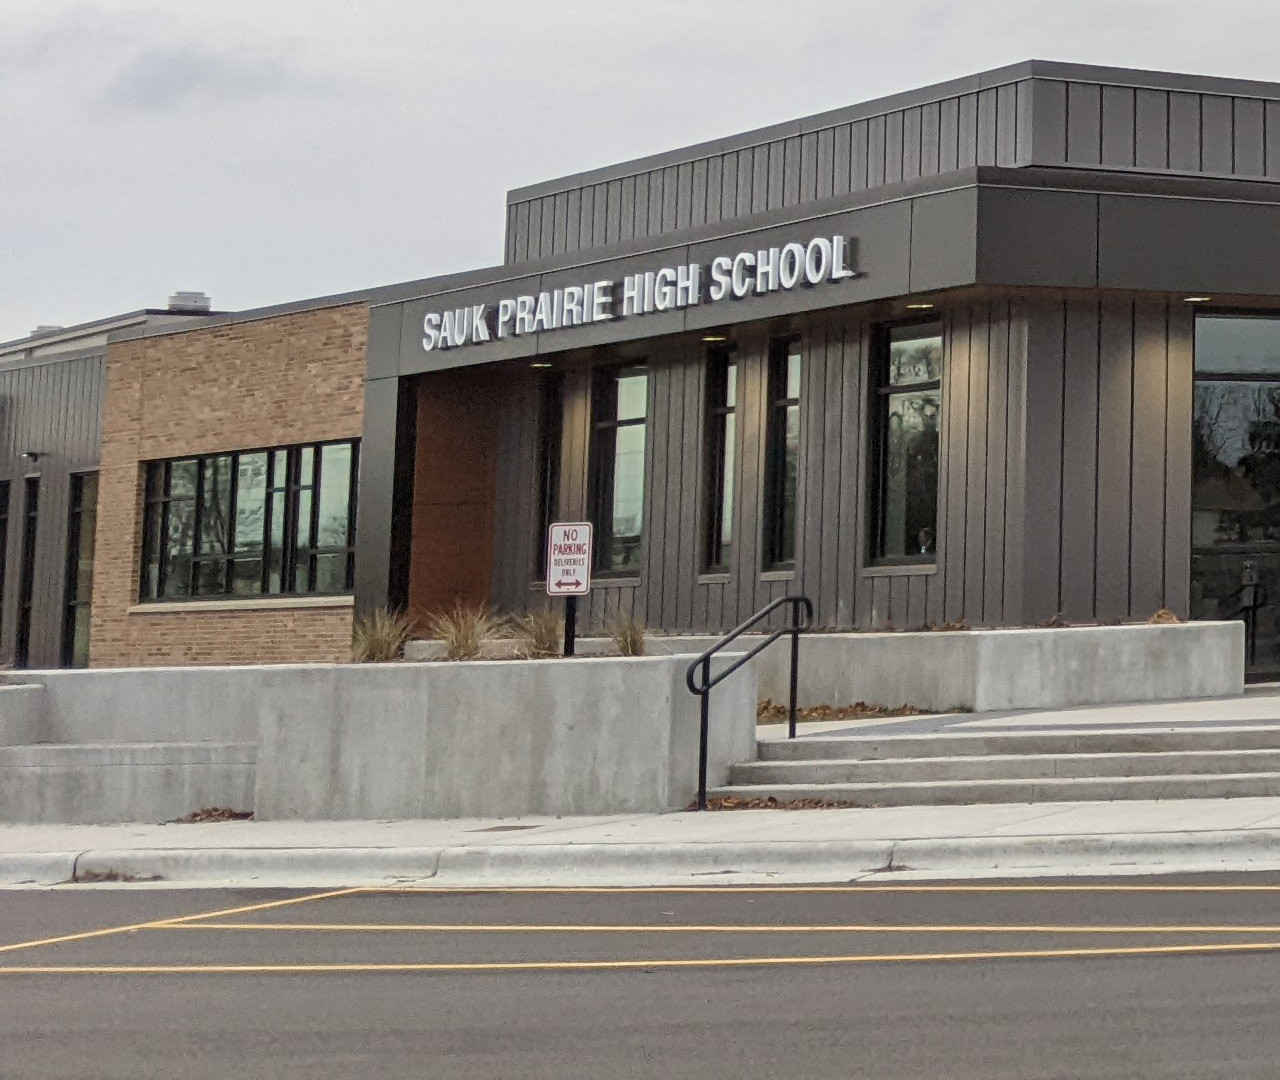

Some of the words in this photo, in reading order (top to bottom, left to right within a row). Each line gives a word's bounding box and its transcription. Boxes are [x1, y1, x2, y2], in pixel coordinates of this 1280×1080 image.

[422, 305, 492, 351] SAUK
[497, 280, 614, 337] PRAIRIE
[623, 263, 700, 315] HIGH
[710, 235, 854, 300] SCHOOL
[563, 528, 578, 542] NO
[553, 543, 586, 556] PARKING
